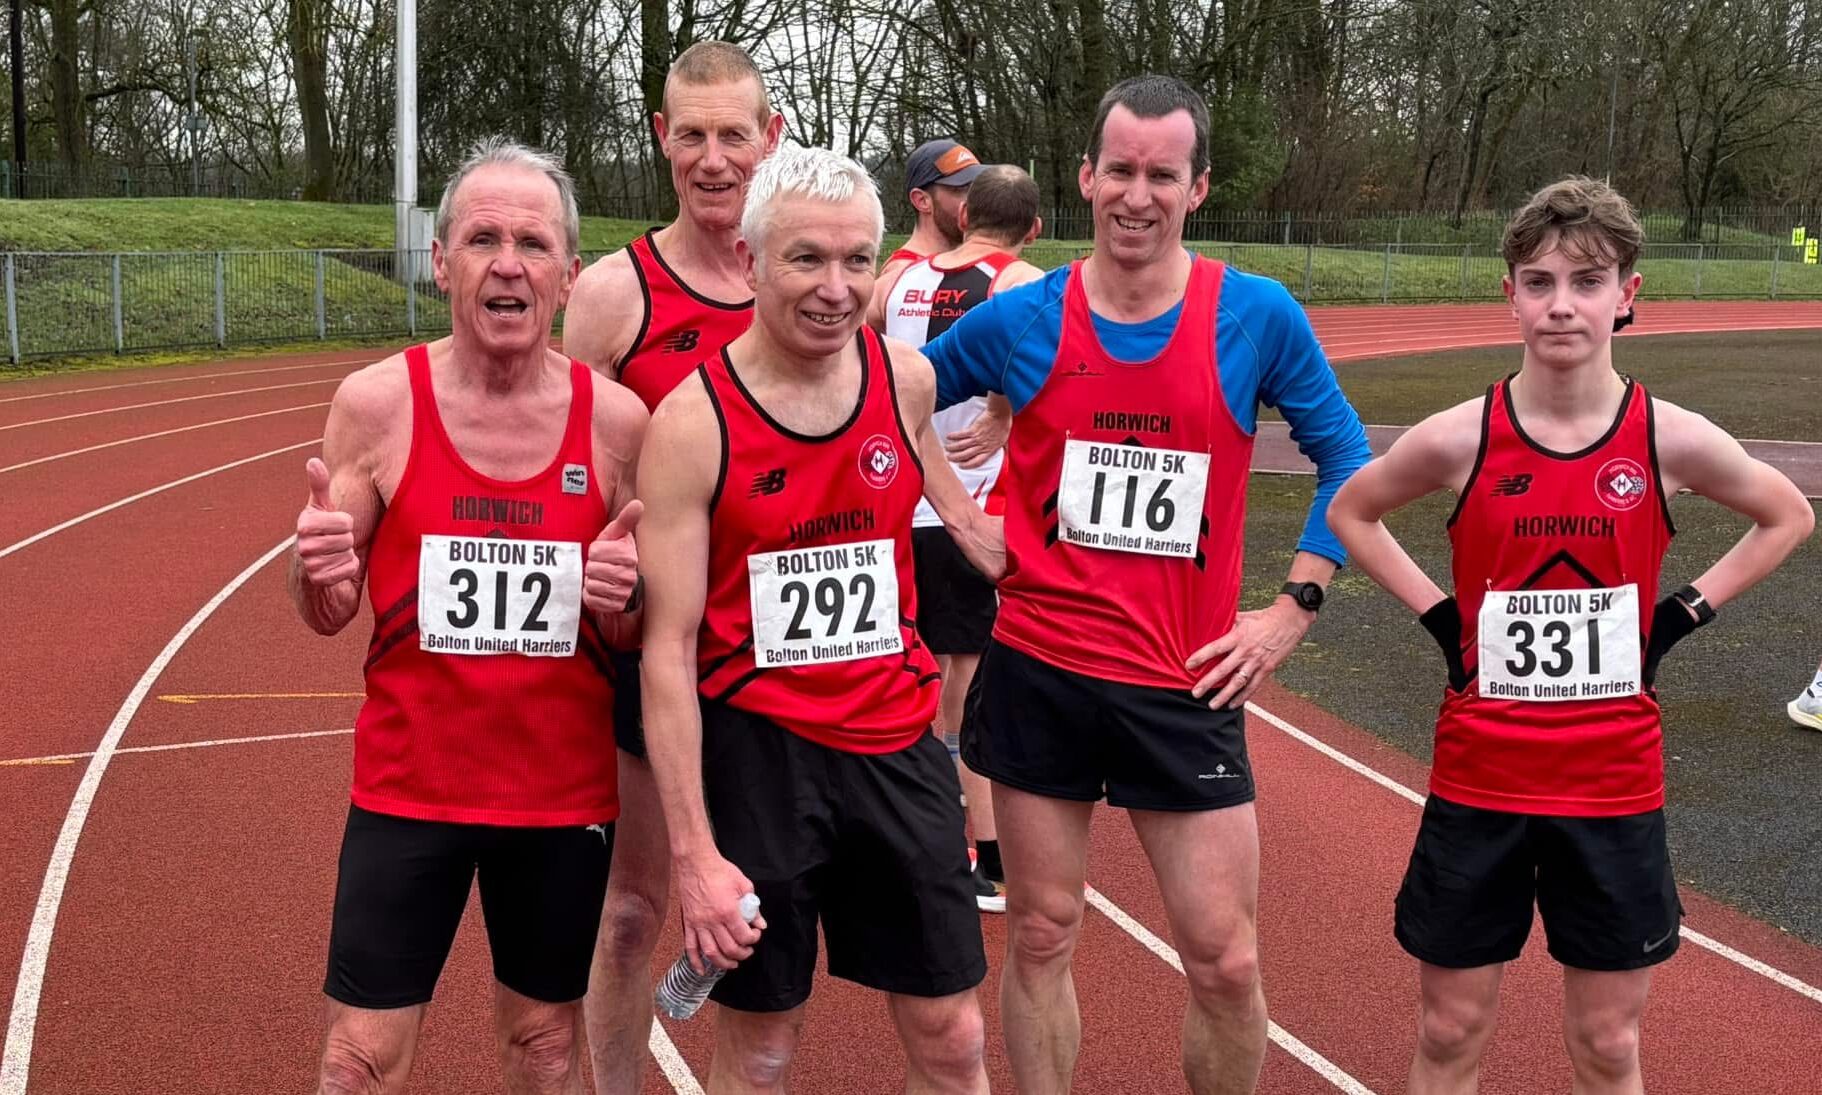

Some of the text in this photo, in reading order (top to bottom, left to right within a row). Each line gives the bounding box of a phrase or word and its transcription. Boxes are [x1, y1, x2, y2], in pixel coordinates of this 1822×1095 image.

[903, 289, 968, 304] BURY
[1093, 411, 1172, 433] HORWICH
[1088, 446, 1187, 474] BOLTON 5K
[452, 495, 544, 526] HORWICH
[1089, 471, 1176, 532] 116
[788, 507, 875, 543] HORWICH
[1514, 515, 1616, 538] HORWICH
[449, 540, 558, 567] BOLTON 5K
[1066, 527, 1192, 554] Bolton United Harriers
[776, 545, 878, 577] BOLTON 5K
[446, 568, 552, 632] 312
[780, 573, 877, 641] 292
[1505, 592, 1614, 615] BOLTON 5K
[427, 633, 572, 654] Bolton United Harriers
[766, 636, 900, 664] Bolton United Harriers
[1505, 618, 1601, 678] 331
[1489, 680, 1635, 697] Bolton United Harriers
